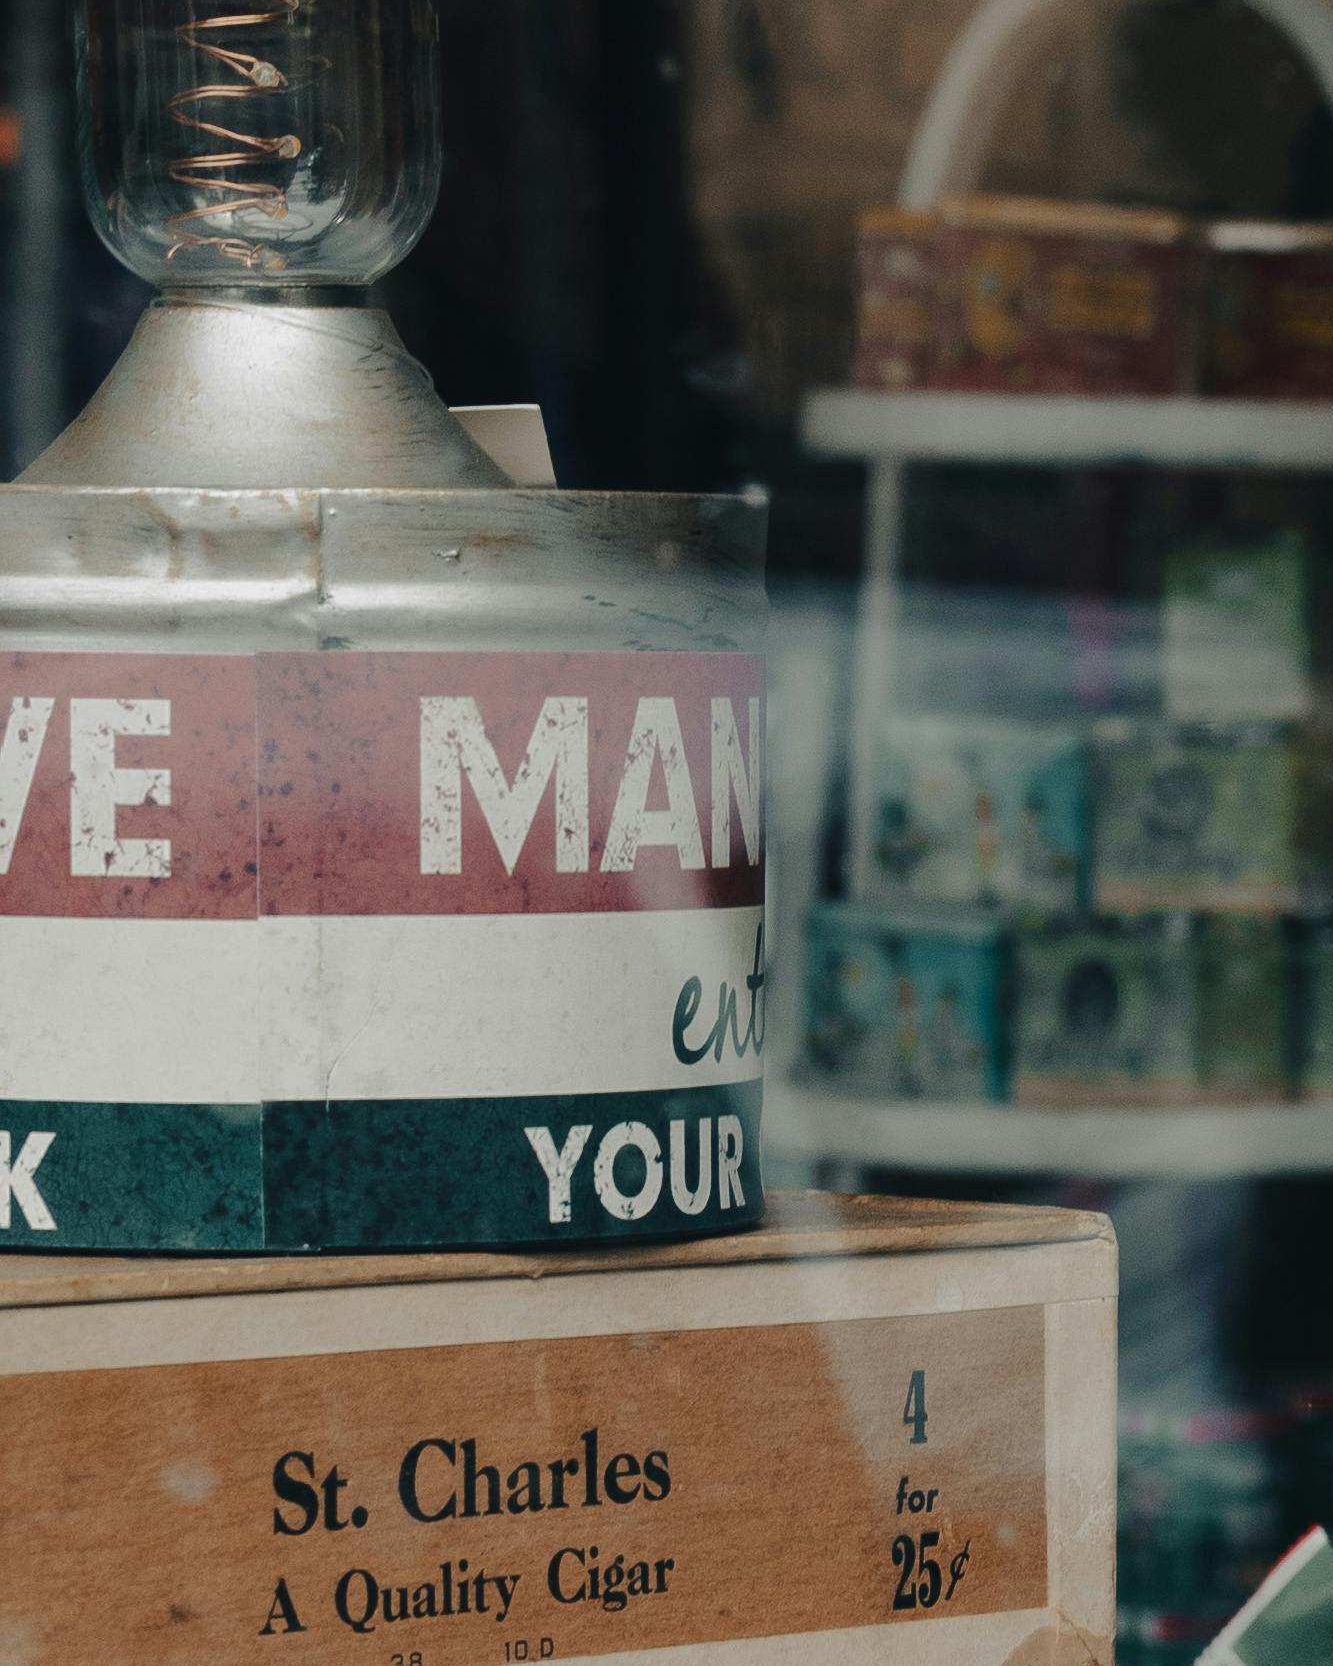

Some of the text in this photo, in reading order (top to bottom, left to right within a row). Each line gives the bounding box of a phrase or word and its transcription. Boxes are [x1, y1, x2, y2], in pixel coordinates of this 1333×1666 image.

[419, 695, 760, 875] MAN
[672, 922, 766, 1065] ent
[523, 1113, 745, 1225] YOUR
[902, 1369, 927, 1445] 4
[272, 1428, 672, 1536] St. Charles
[895, 1478, 939, 1516] for
[259, 1545, 675, 1637] A Quality Cigar
[890, 1534, 972, 1612] 25¢
[505, 1640, 527, 1662] 10
[540, 1637, 554, 1657] D
